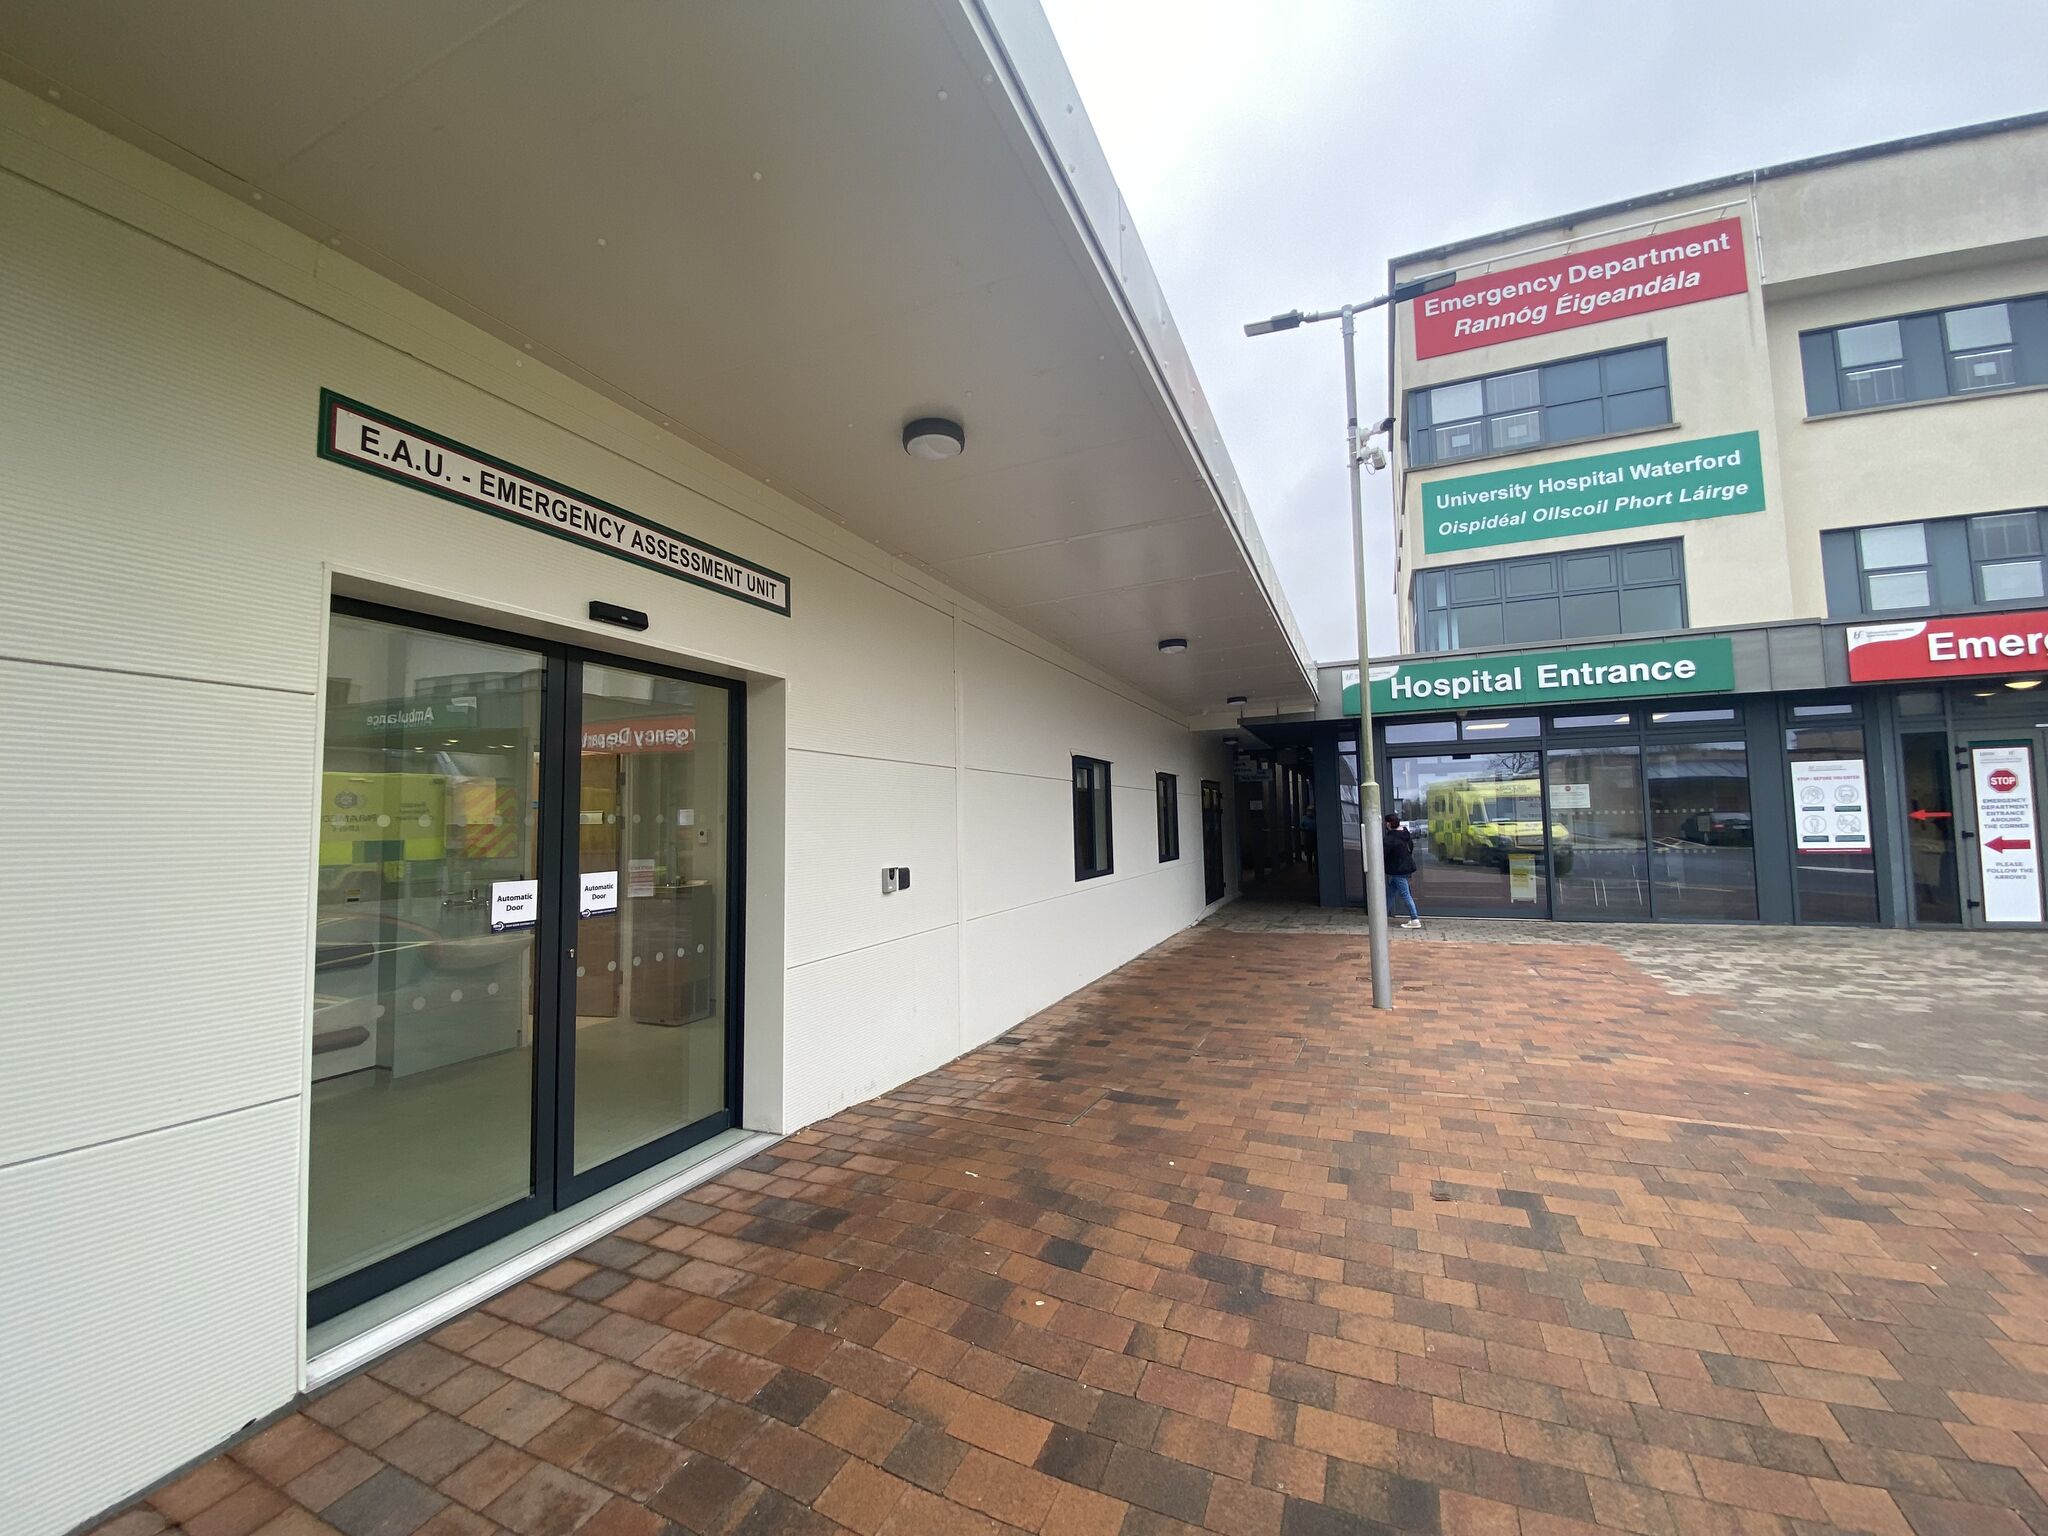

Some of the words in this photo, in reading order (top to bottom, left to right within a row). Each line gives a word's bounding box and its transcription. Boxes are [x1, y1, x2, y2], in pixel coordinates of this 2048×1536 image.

[1424, 272, 1563, 317] Emergency
[1568, 232, 1731, 285] Department
[1454, 304, 1547, 337] Rannóg
[1555, 270, 1700, 316] Éigeandála
[1436, 481, 1532, 510] University
[1538, 468, 1624, 495] Hospital
[1629, 450, 1742, 481] Waterford
[361, 424, 452, 483] E.A.U.
[480, 470, 627, 543] EMERGENCY
[630, 530, 743, 588] ASSESSMENT
[746, 574, 778, 601] UNIT
[1438, 505, 1527, 536] Oispidéal
[1532, 494, 1608, 523] Ollscoil
[1614, 493, 1673, 513] Phort
[1679, 480, 1749, 503] Láirge
[1927, 631, 2048, 661] Emer
[1390, 666, 1522, 701] Hospital
[1537, 659, 1697, 690] Entrance
[1990, 776, 2016, 786] STOP
[497, 893, 533, 902] Automatic
[506, 904, 524, 912] Door
[584, 883, 614, 892] Automatic
